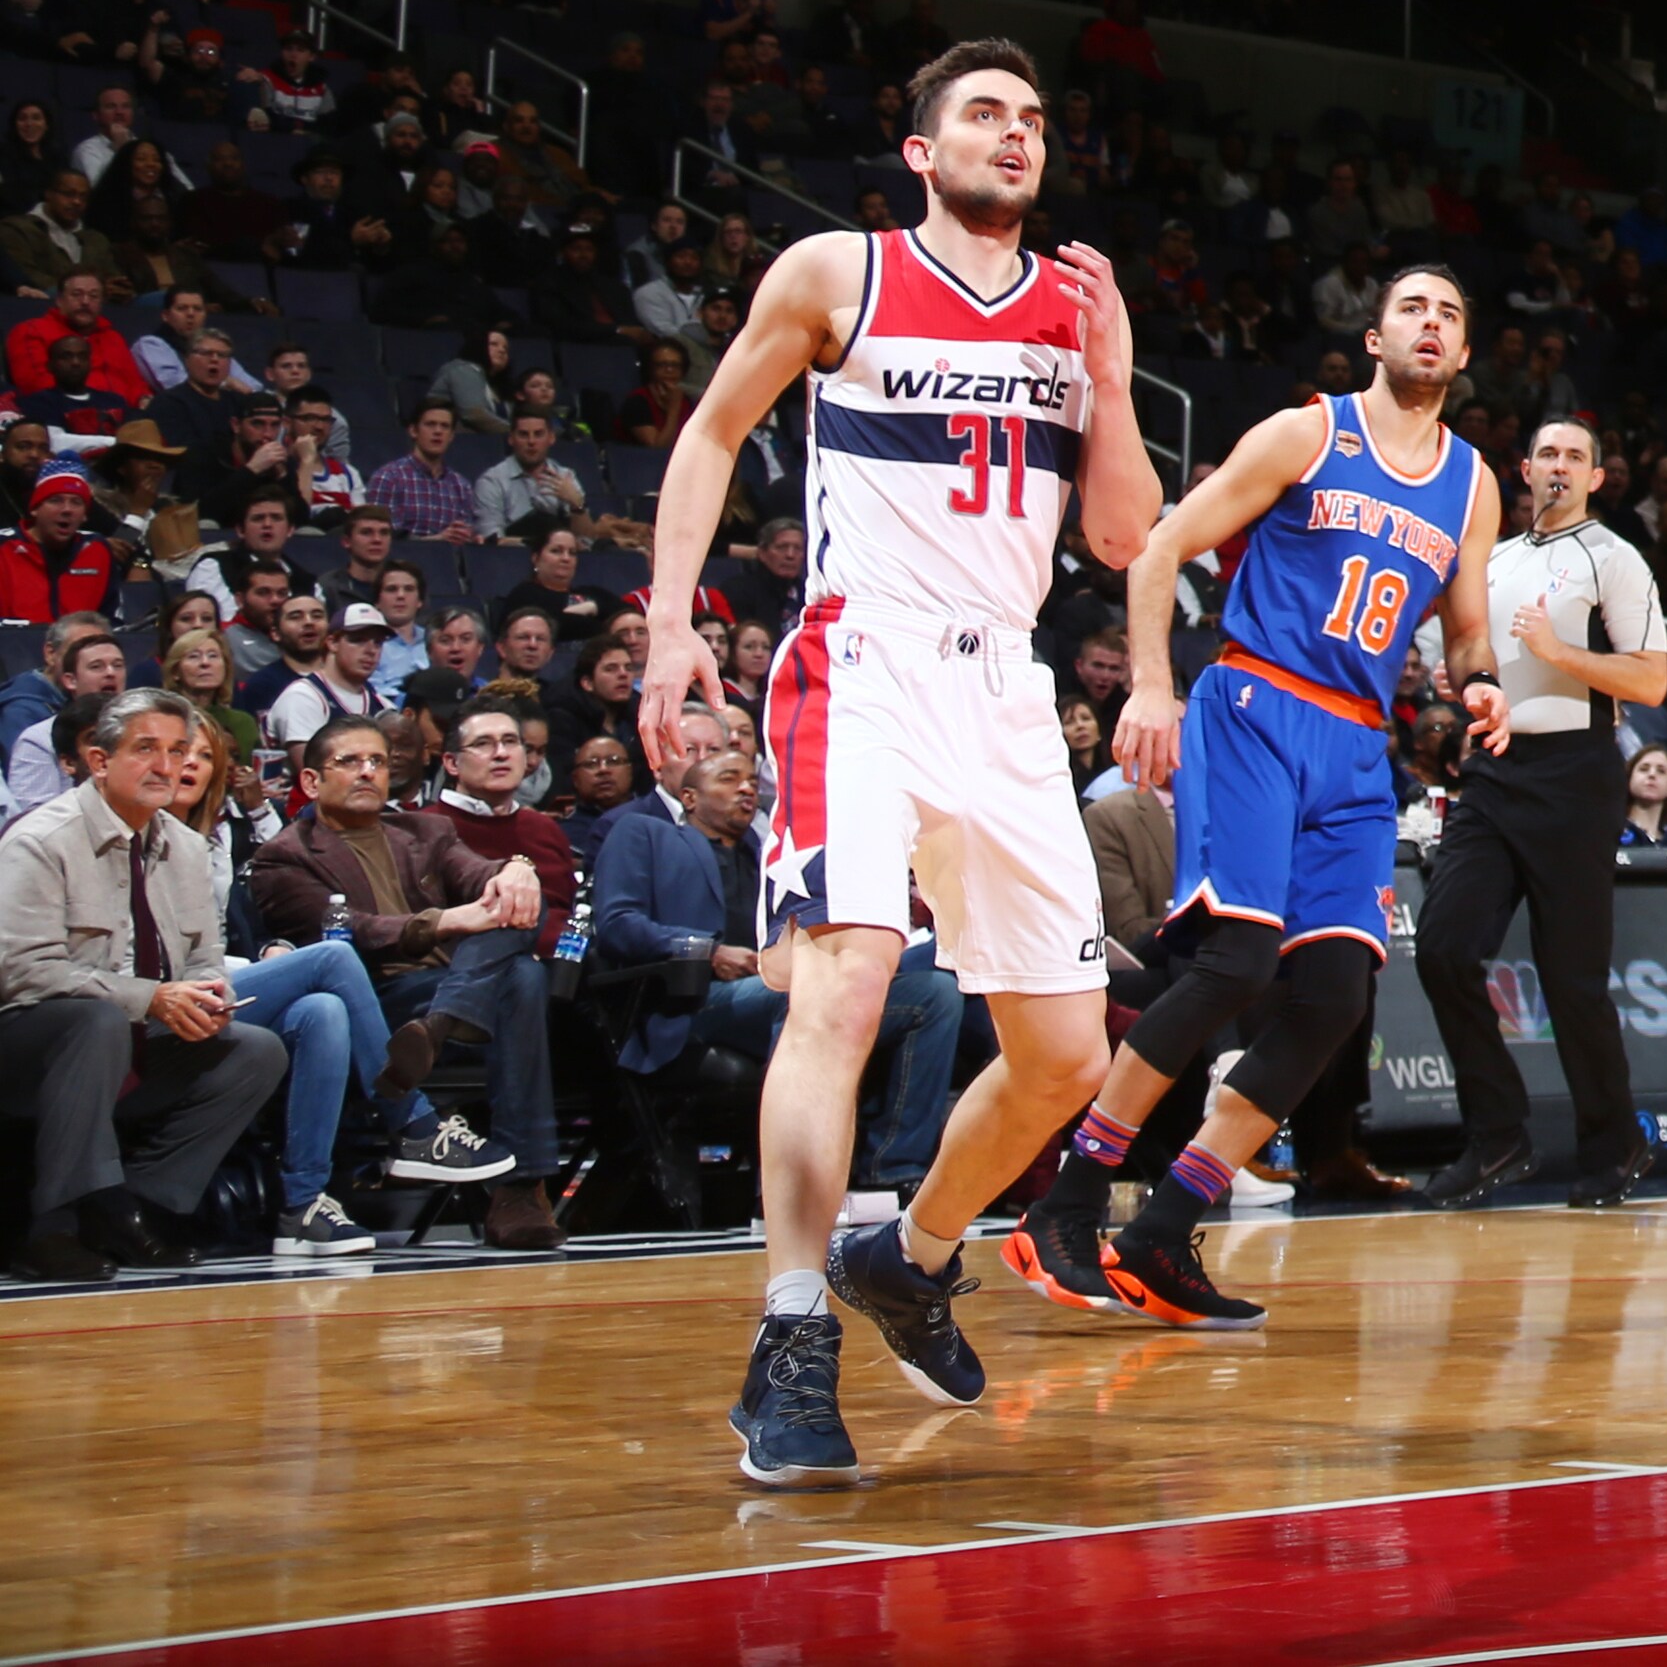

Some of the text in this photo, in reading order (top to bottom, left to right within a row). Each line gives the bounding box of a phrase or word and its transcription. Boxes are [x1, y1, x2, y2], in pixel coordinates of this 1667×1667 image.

[883, 357, 1071, 410] wizards
[947, 411, 1029, 521] 31
[1307, 488, 1459, 584] NEW YORK
[1322, 554, 1410, 657] 18
[1386, 1054, 1456, 1091] WGL
